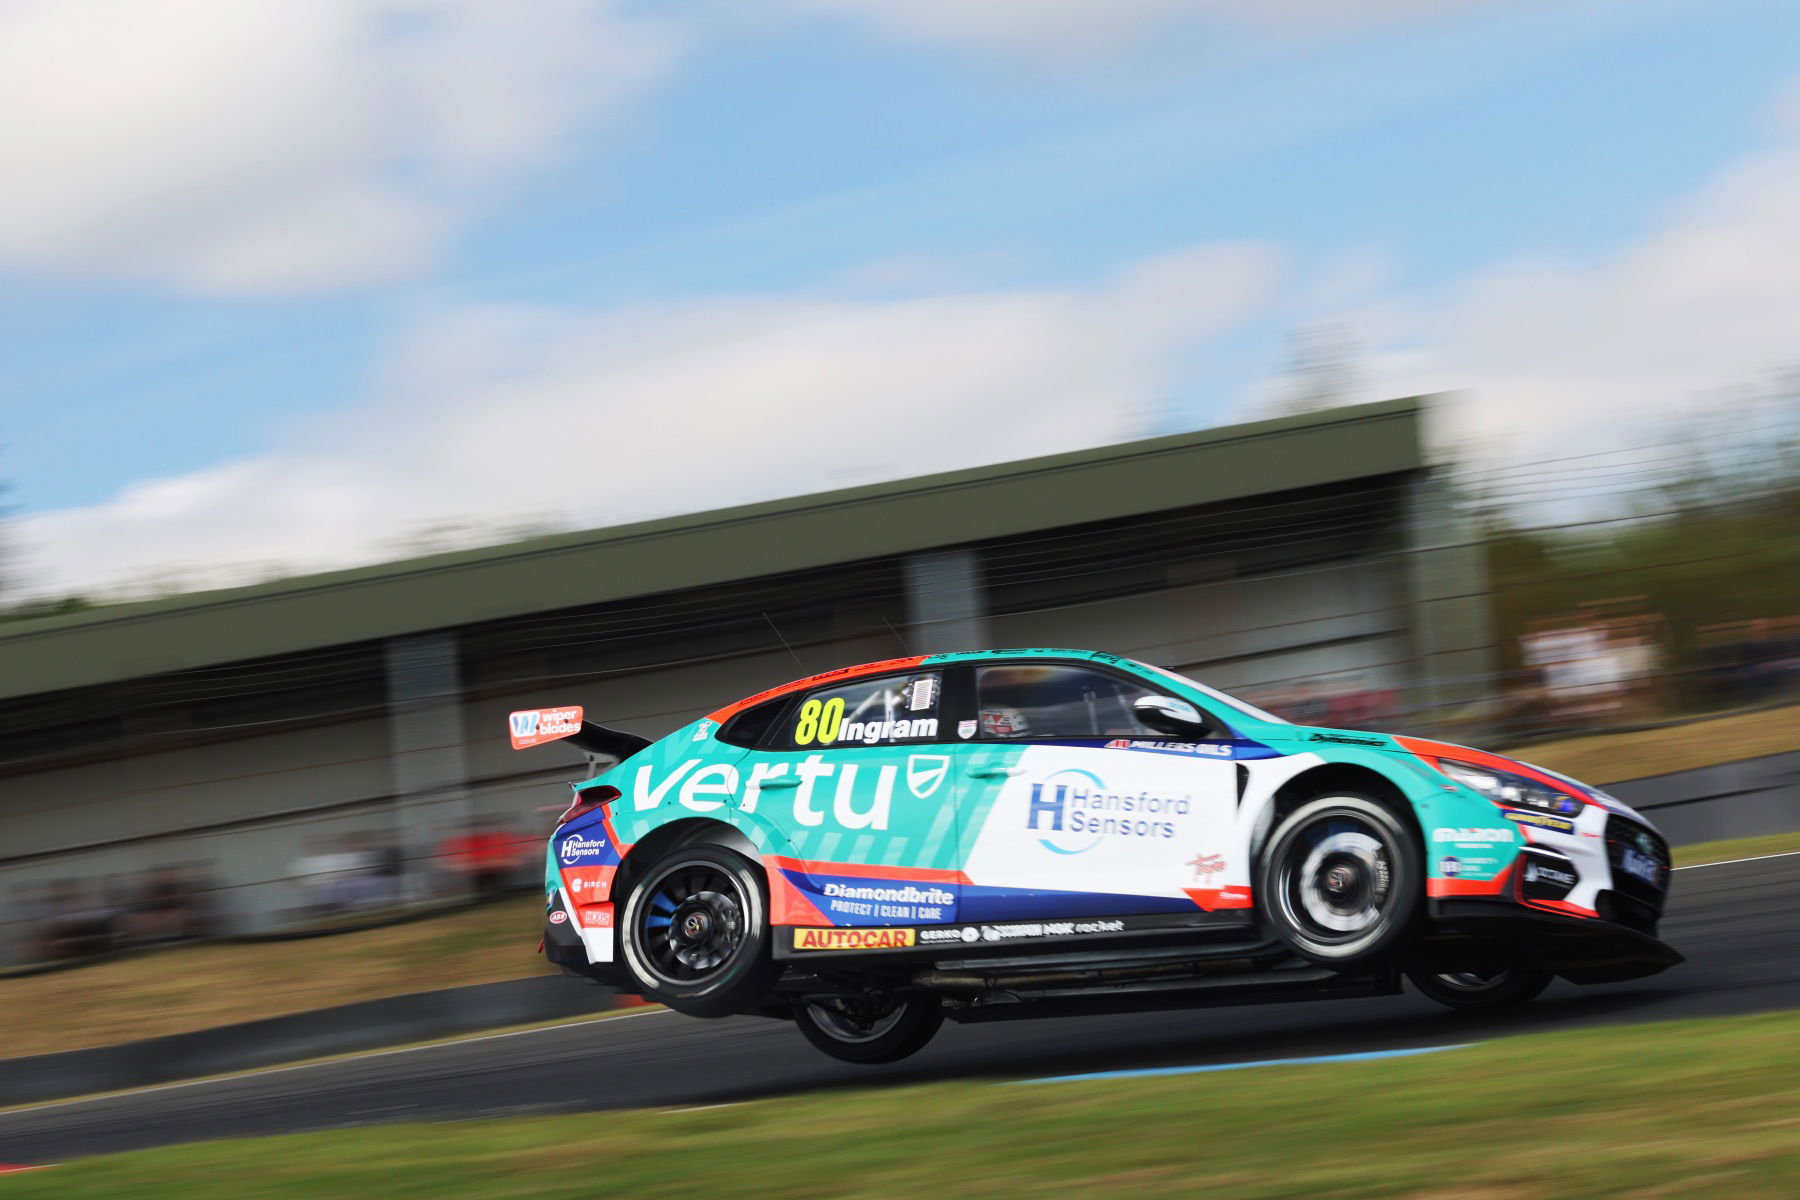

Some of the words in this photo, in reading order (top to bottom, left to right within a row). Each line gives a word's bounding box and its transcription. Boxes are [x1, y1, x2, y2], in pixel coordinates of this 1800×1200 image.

[542, 709, 577, 725] wiper
[794, 697, 845, 745] 80
[837, 717, 939, 744] Ingram
[540, 722, 581, 735] blades
[633, 754, 899, 831] vertu
[1070, 787, 1191, 816] Hansford
[1069, 810, 1176, 839] Sensors
[571, 847, 600, 857] Sensors
[572, 838, 606, 849] Hansford
[583, 881, 607, 889] BIRCH
[823, 883, 955, 906] Diamondbrite
[830, 899, 873, 917] PROTECT
[880, 905, 910, 919] CLEAN
[918, 907, 942, 920] CARE
[801, 930, 908, 948] AUTOCAR
